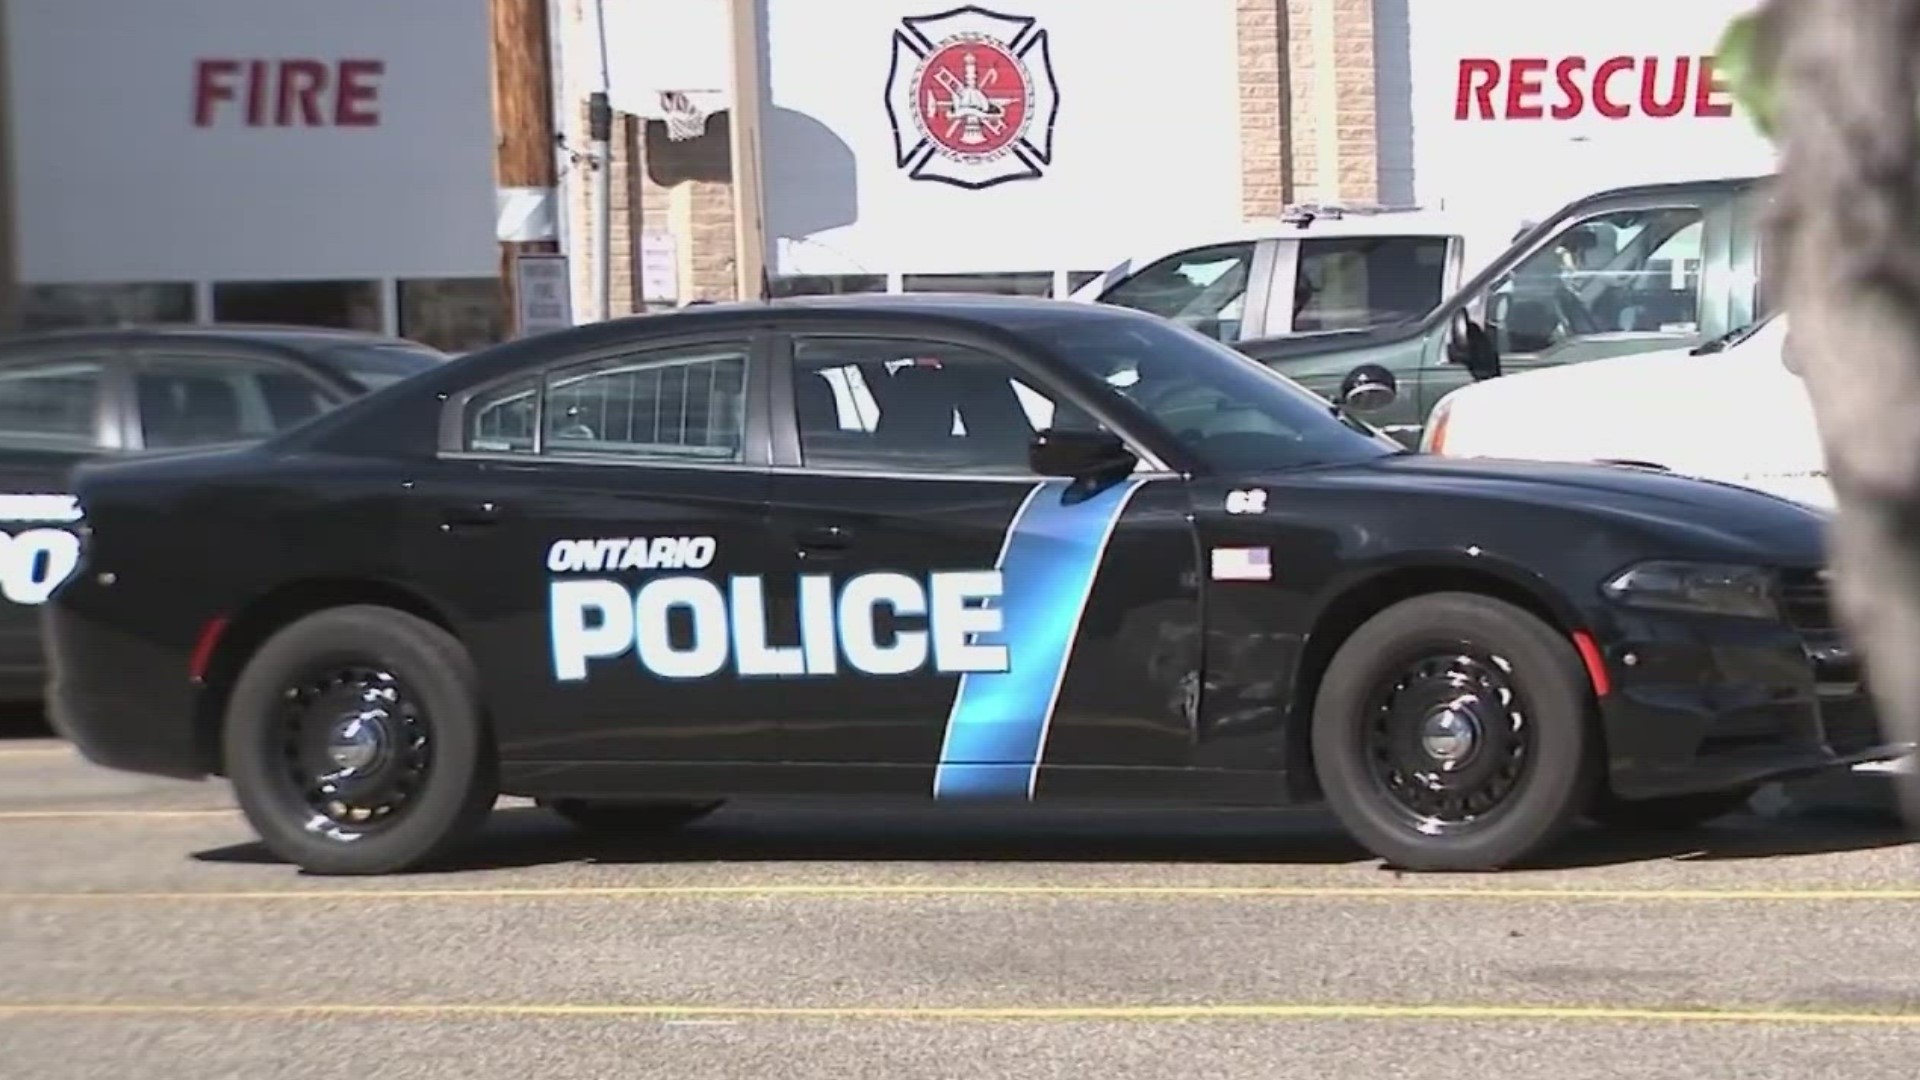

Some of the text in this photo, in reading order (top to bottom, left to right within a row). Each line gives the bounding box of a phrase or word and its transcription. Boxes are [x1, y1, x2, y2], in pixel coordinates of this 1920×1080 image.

[193, 58, 385, 127] FIRE
[1454, 56, 1733, 121] RESCUE
[547, 536, 716, 572] ONTARIO
[550, 570, 1010, 681] POLICE
